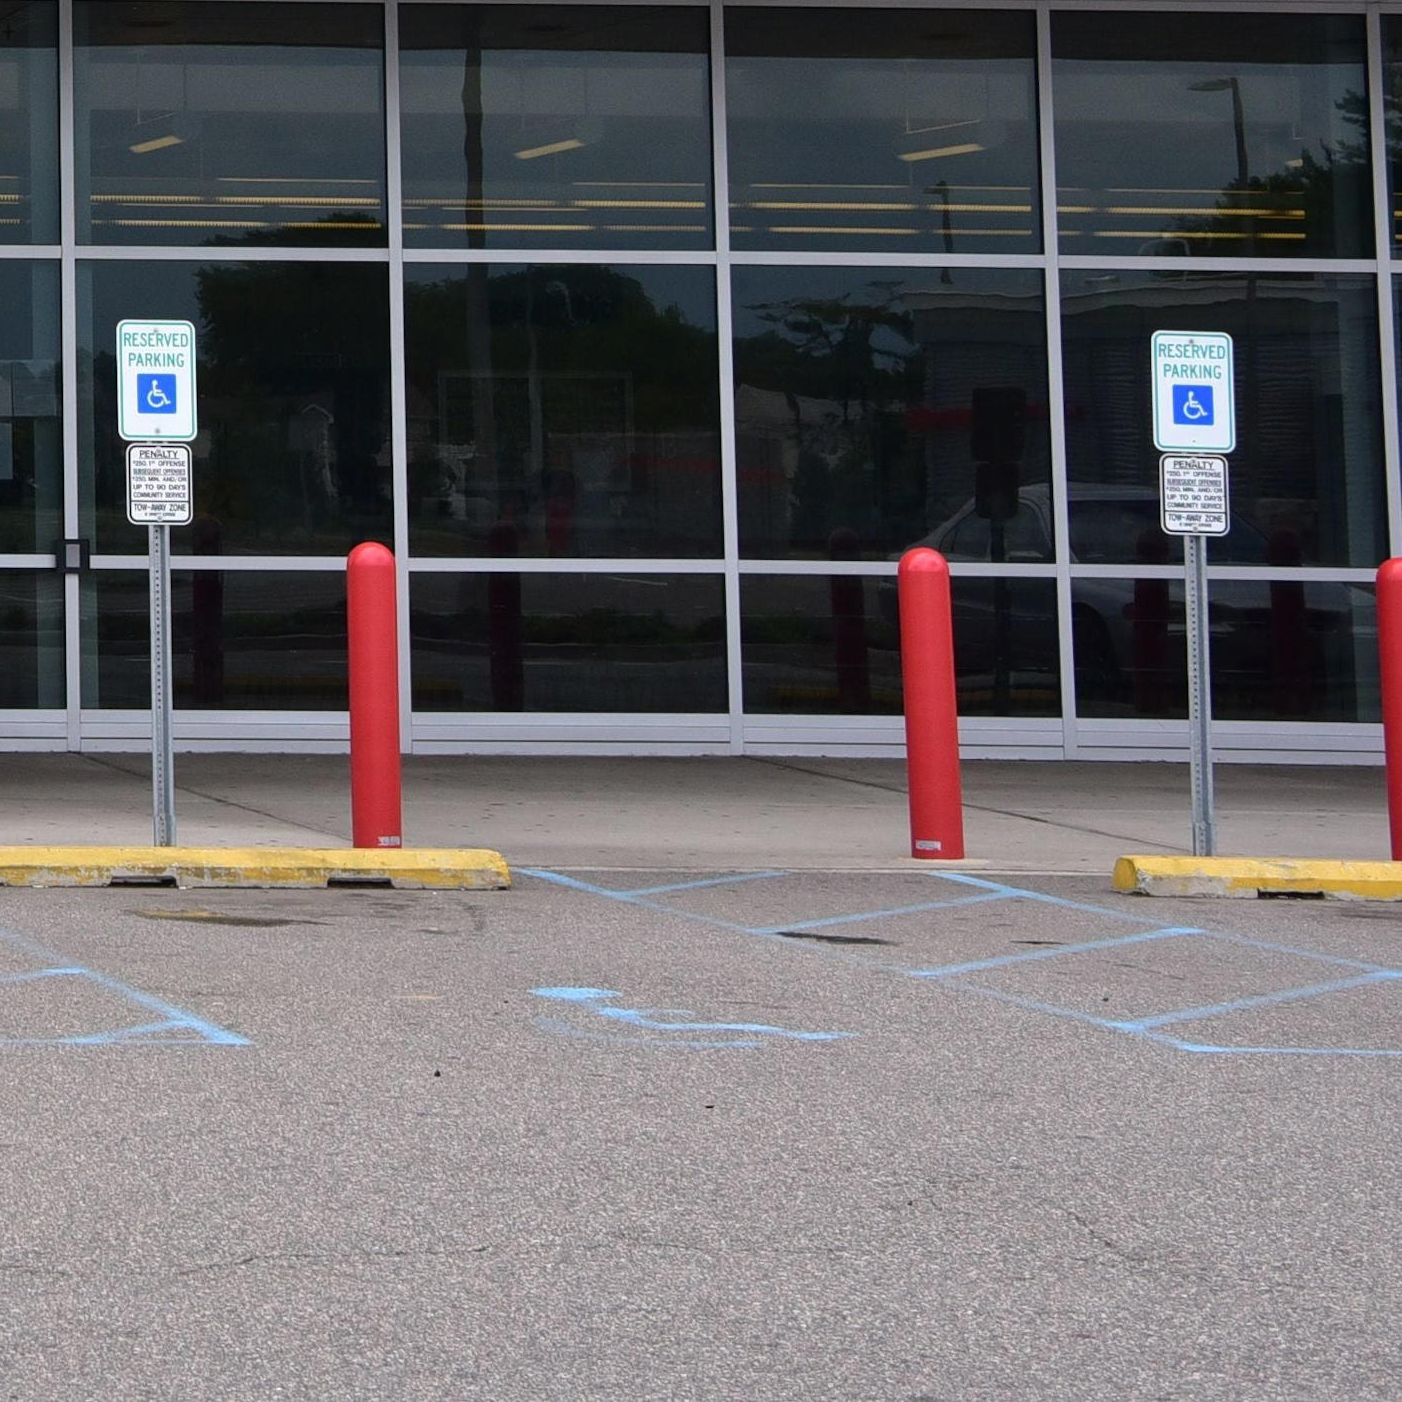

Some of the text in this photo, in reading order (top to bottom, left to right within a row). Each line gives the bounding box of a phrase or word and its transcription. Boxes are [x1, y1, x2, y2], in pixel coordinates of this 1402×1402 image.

[124, 332, 189, 348] RESERVED
[1158, 343, 1225, 359] RESERVED
[128, 353, 184, 368] PARKING
[1163, 364, 1222, 379] PARKING
[139, 450, 178, 459] PENALTY
[1173, 461, 1214, 469] PENALTY
[1168, 514, 1223, 523] TOW-AWAY ZONE
